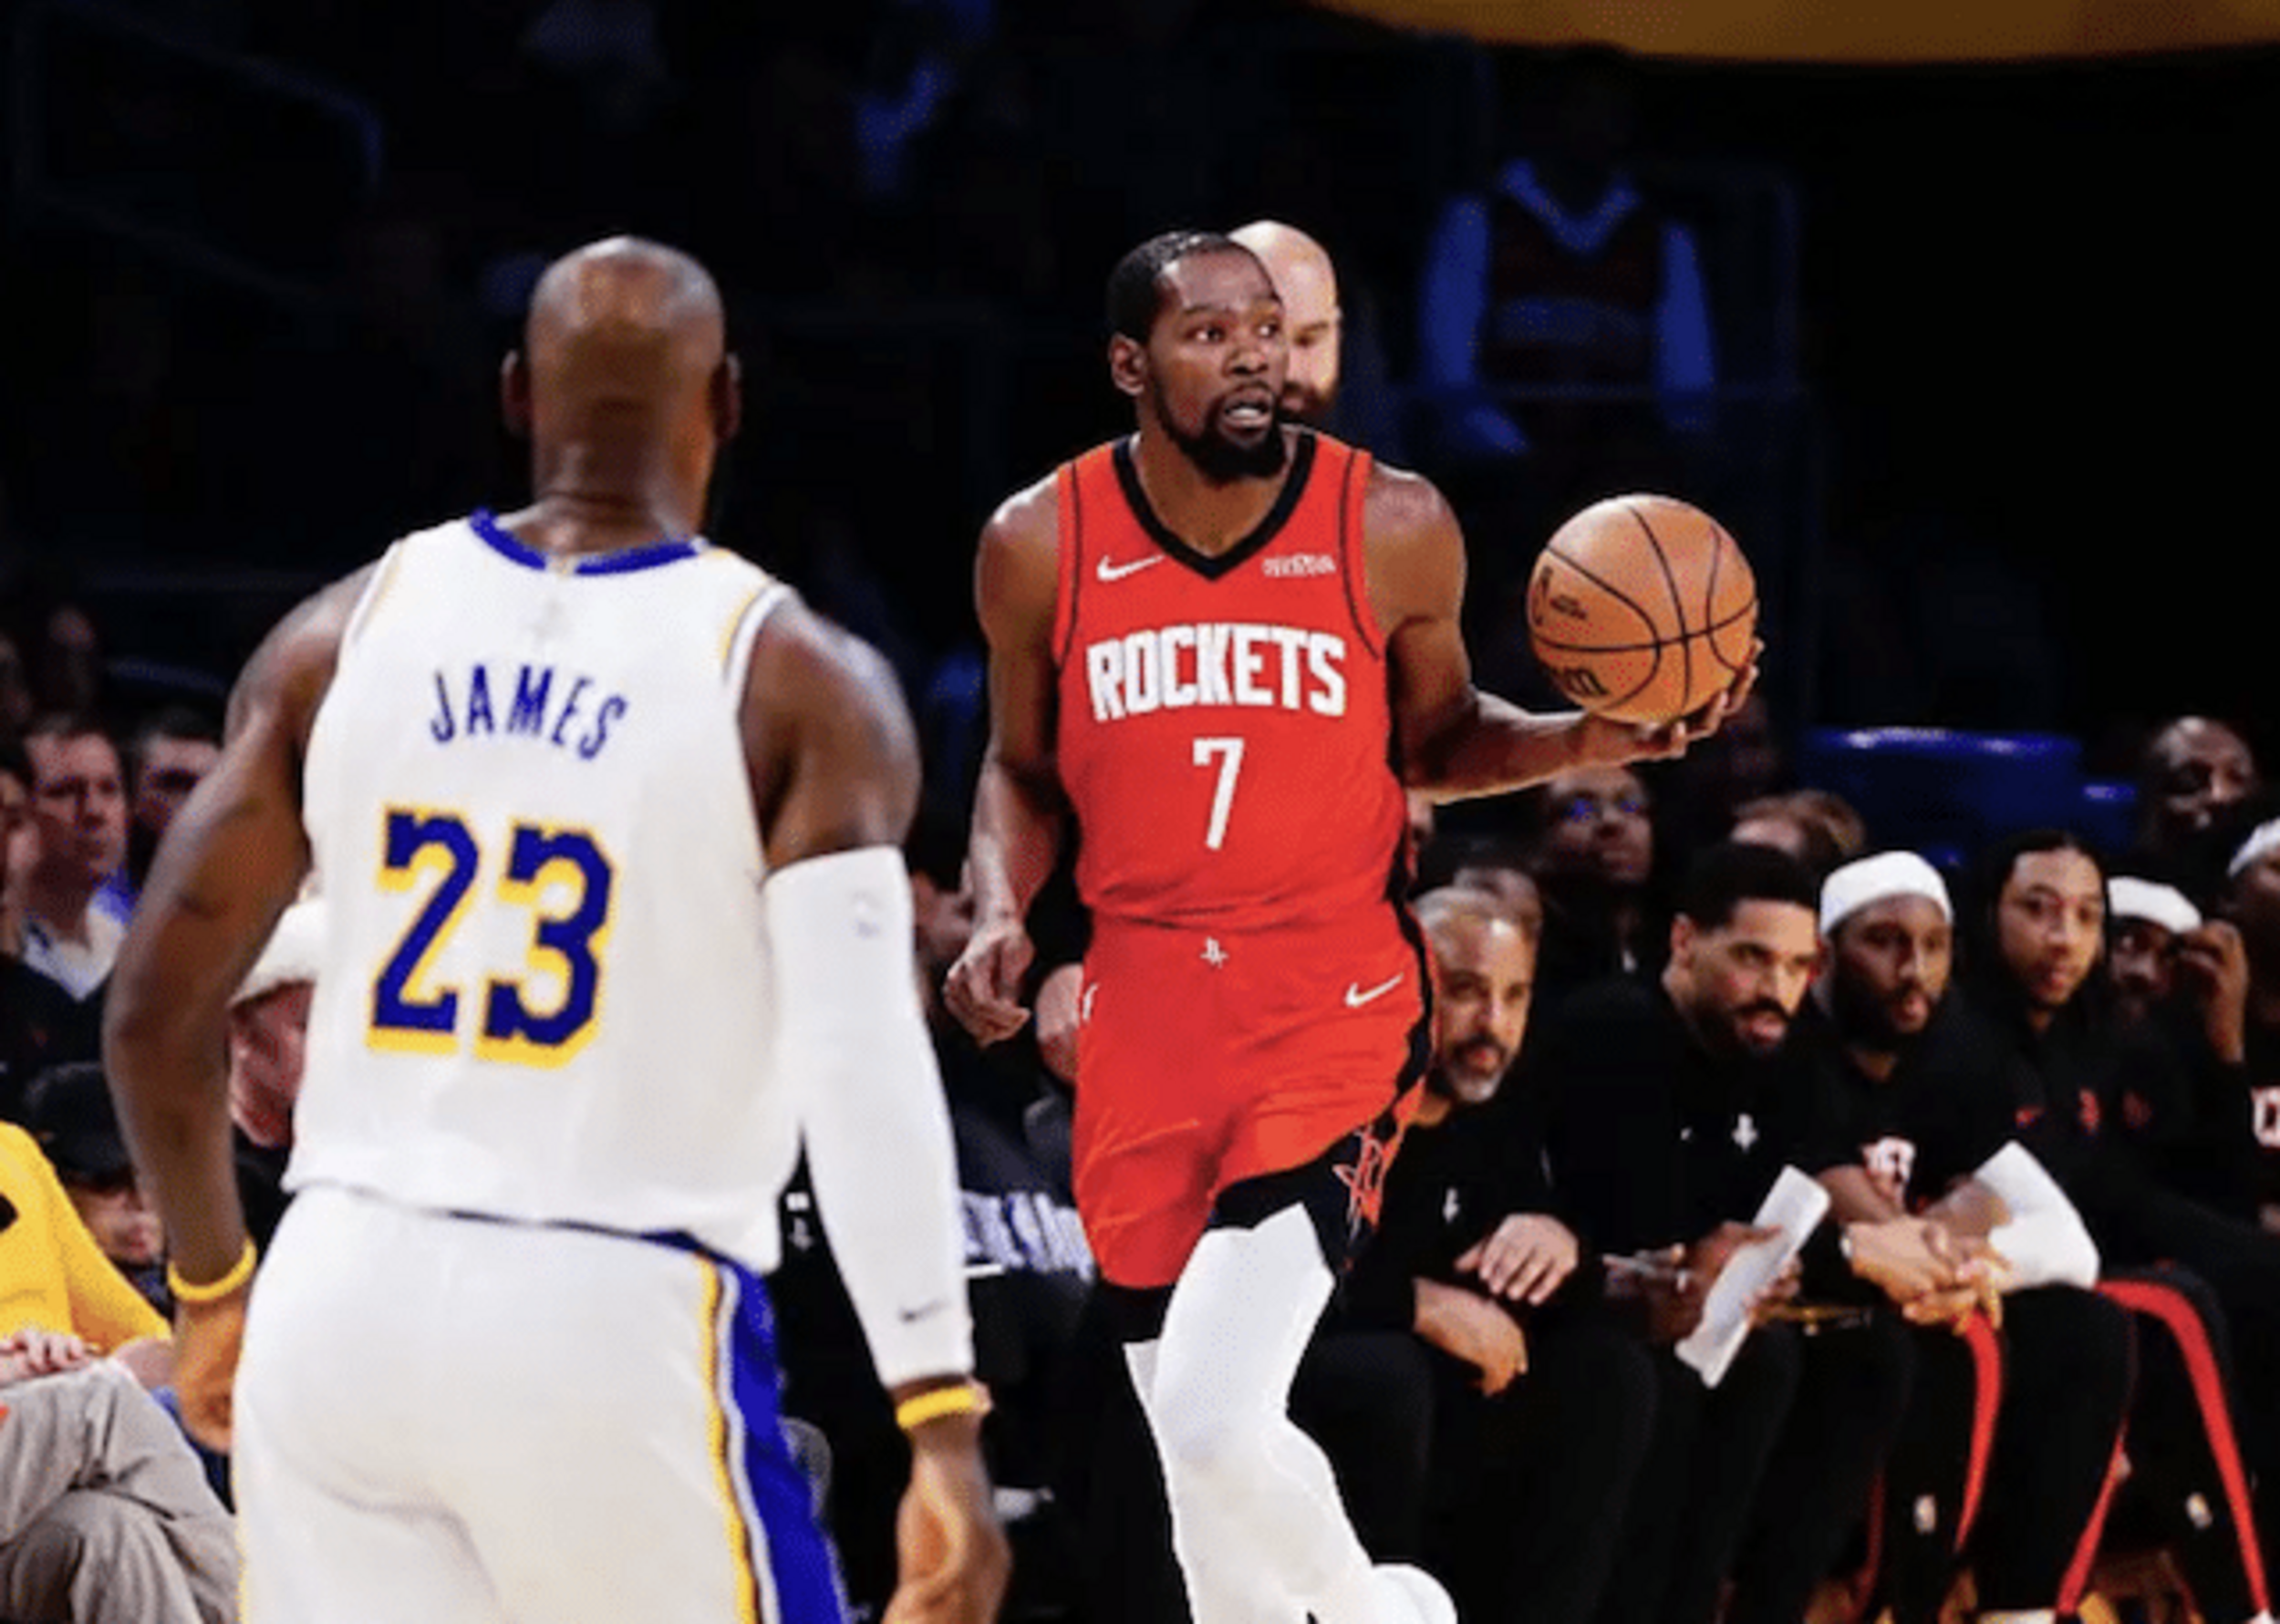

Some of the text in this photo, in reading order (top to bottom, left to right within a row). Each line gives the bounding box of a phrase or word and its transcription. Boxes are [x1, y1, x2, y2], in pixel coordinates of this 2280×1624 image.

[430, 665, 626, 759] JAMES
[1087, 622, 1346, 721] ROCKETS
[1193, 737, 1245, 850] 7
[366, 802, 619, 1067] 23
